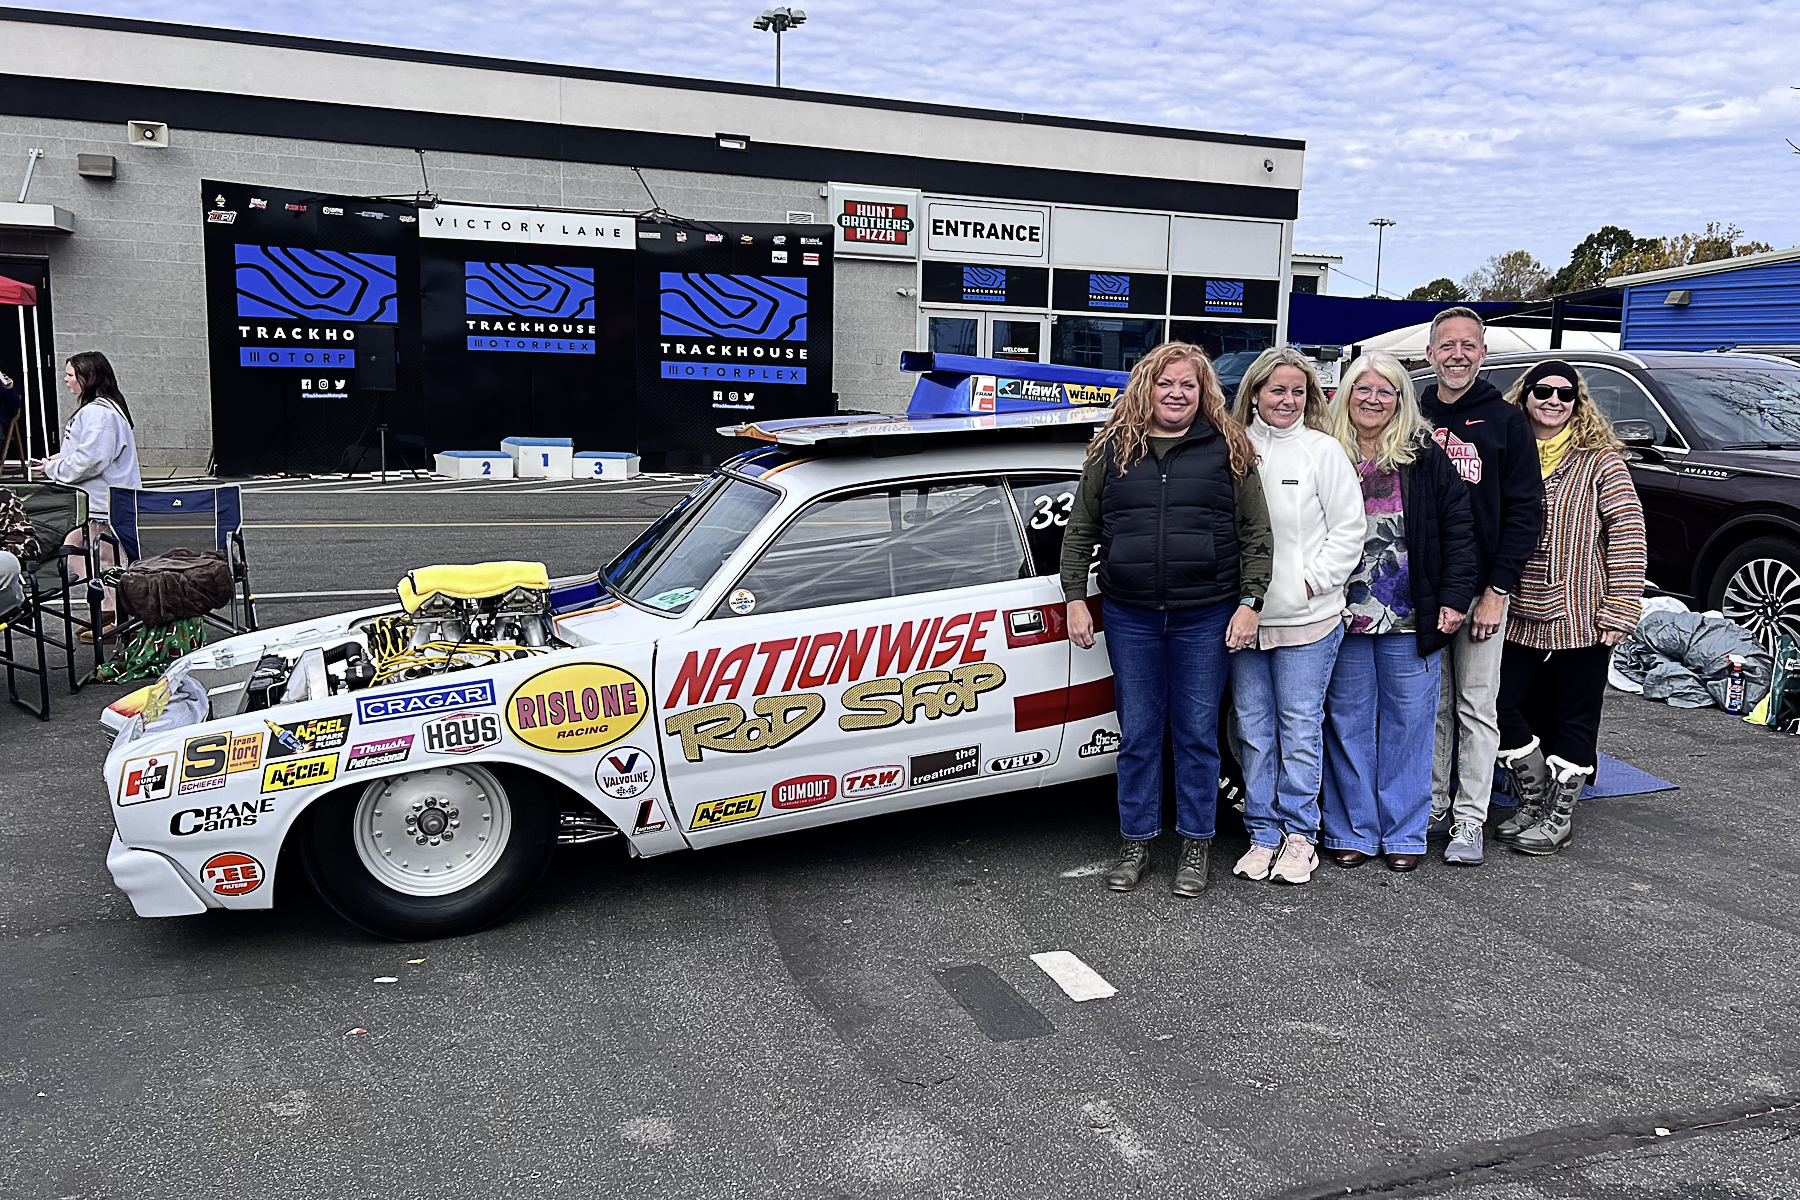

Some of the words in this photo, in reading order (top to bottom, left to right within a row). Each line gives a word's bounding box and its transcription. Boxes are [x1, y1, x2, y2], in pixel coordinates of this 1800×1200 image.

[856, 203, 895, 218] HUNT
[435, 217, 545, 233] VICTORY
[562, 225, 621, 238] LANE
[841, 215, 910, 231] BROTHERS
[932, 219, 1041, 243] ENTRANCE
[856, 229, 896, 242] PIZZA
[238, 326, 355, 341] TRACKHO
[466, 320, 596, 334] TRACKHOUSE
[660, 343, 808, 360] TRACKHOUSE
[1021, 380, 1062, 398] Hawk
[1069, 389, 1111, 402] WEIAND
[482, 461, 491, 475] 2
[542, 453, 549, 467] 1
[594, 461, 603, 475] 3
[1684, 467, 1728, 478] AVIATOR
[663, 609, 997, 709] NATIONWISE
[366, 687, 483, 716] CRAGAR
[516, 682, 639, 729] RISLONE
[295, 719, 346, 740] ACCEL
[316, 732, 344, 740] SPARK
[426, 717, 497, 750] Hays
[556, 724, 609, 739] RACING
[233, 736, 257, 746] trans
[315, 738, 342, 749] PLUGS
[353, 738, 411, 755] Thrush
[232, 745, 258, 760] torq
[349, 749, 407, 769] Professional
[955, 748, 977, 761] the
[998, 753, 1038, 770] VHT
[134, 775, 162, 786] HURST
[270, 762, 329, 786] ACCEL
[603, 770, 649, 788] VALVOLINE
[846, 769, 901, 791] TRW
[913, 759, 977, 785] treatment
[181, 778, 224, 792] SCHIEFER
[779, 779, 830, 803] GUMOUT
[170, 798, 275, 836] CRANE
[698, 798, 757, 823] ACCEL
[207, 865, 258, 883] LEE
[222, 882, 249, 891] FILTERS
